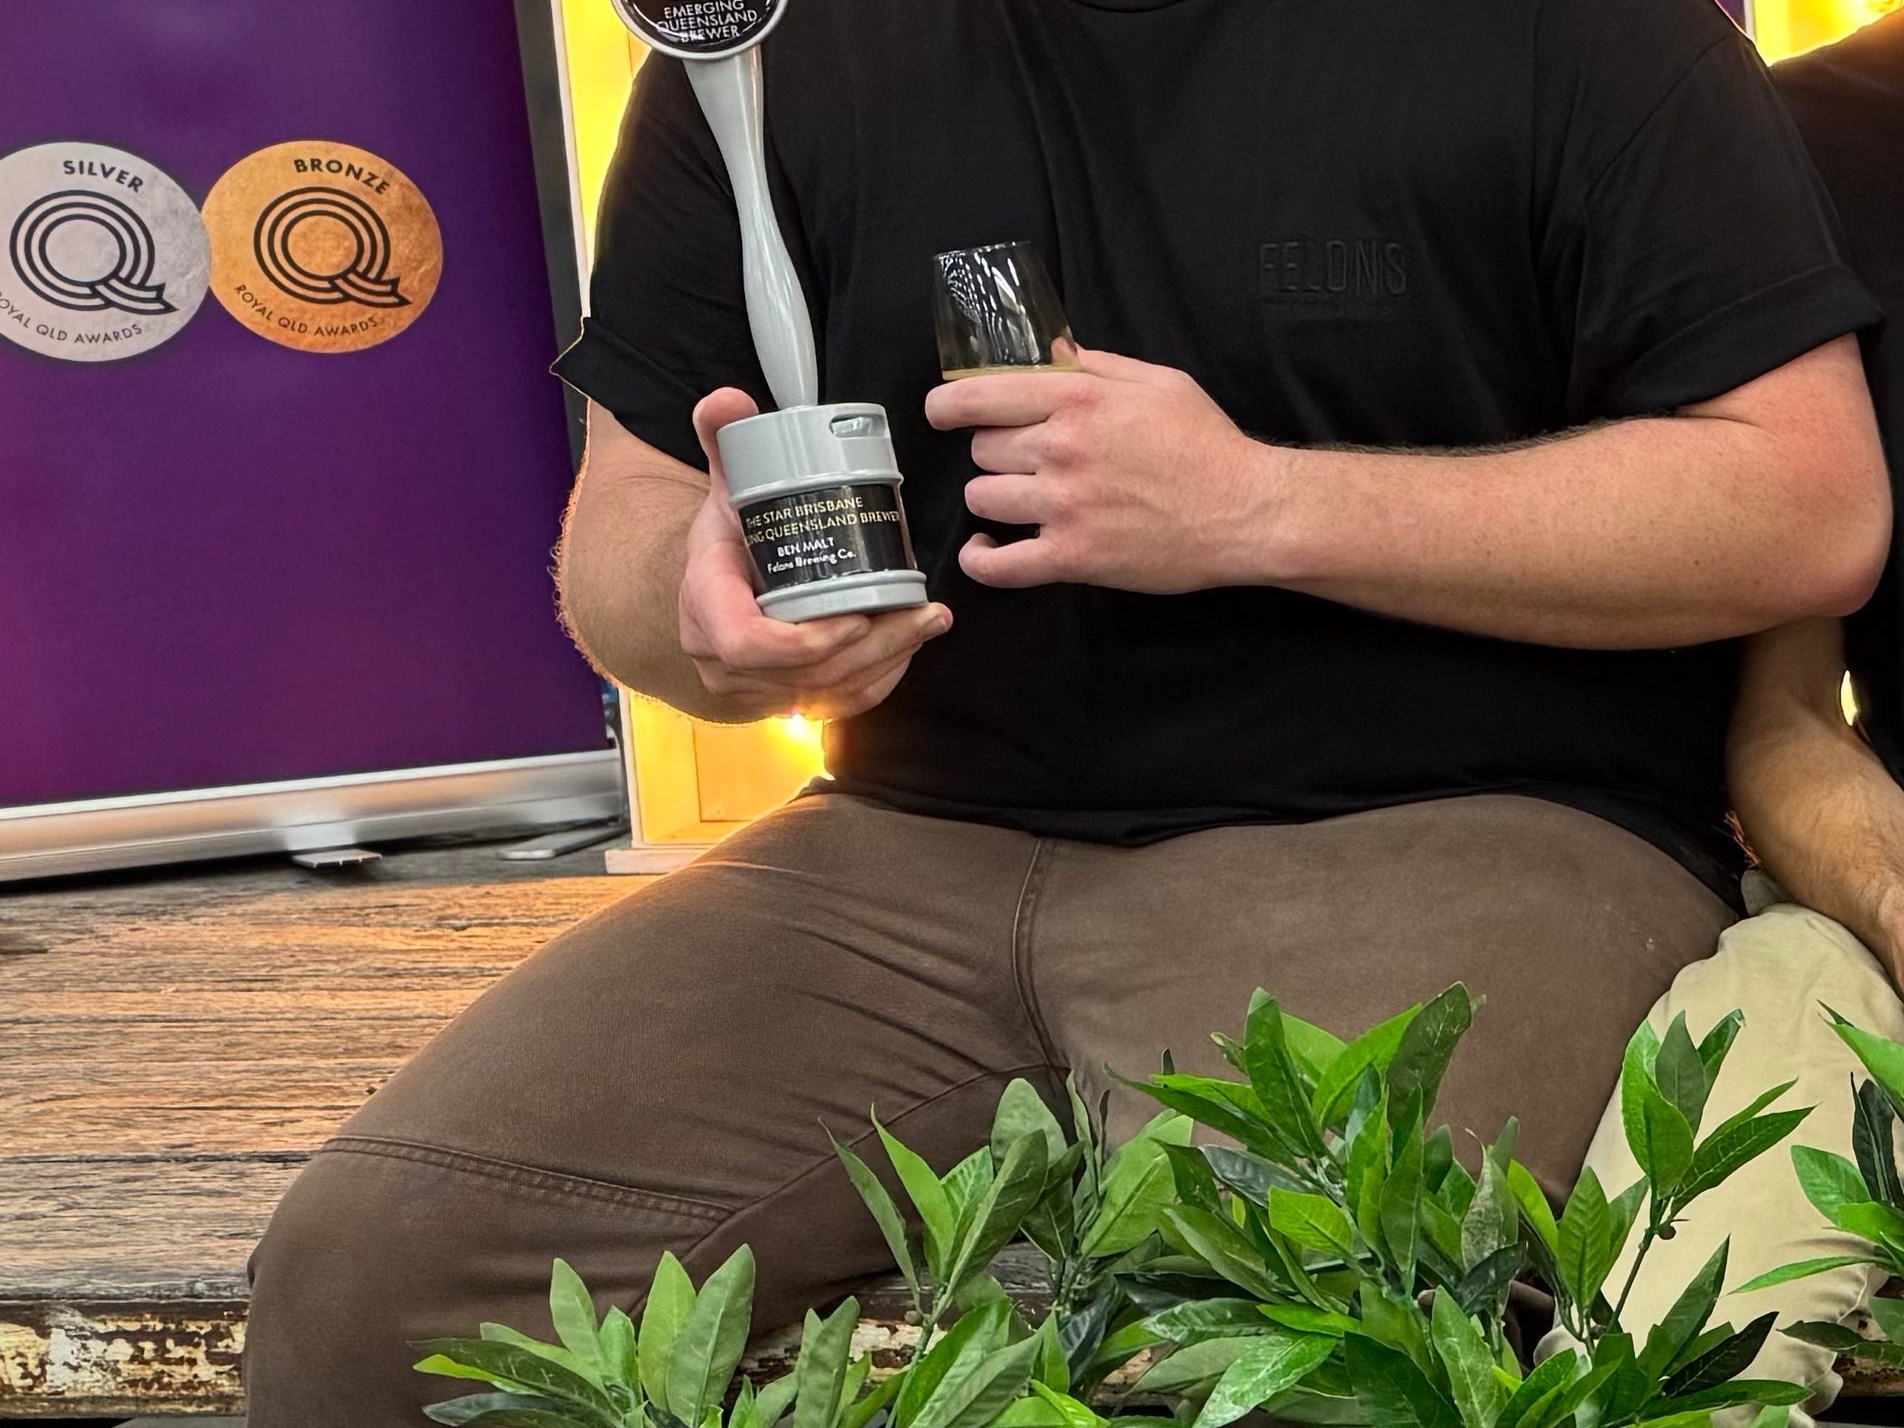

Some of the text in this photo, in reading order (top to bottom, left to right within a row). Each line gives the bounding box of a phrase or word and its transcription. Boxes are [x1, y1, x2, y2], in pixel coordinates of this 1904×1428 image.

[656, 9, 759, 33] QUEENSLAND
[63, 160, 144, 193] SILVER
[294, 158, 391, 195] BRONZE
[1259, 239, 1408, 298] FELONS
[234, 283, 380, 337] ROYAL QLD AWARDS
[36, 323, 68, 341] QLD
[74, 323, 142, 344] AWARDS
[762, 507, 792, 525] STAR
[795, 496, 864, 518] BRISBANE
[766, 512, 858, 542] QUEENSLAND
[802, 536, 835, 554] MALT
